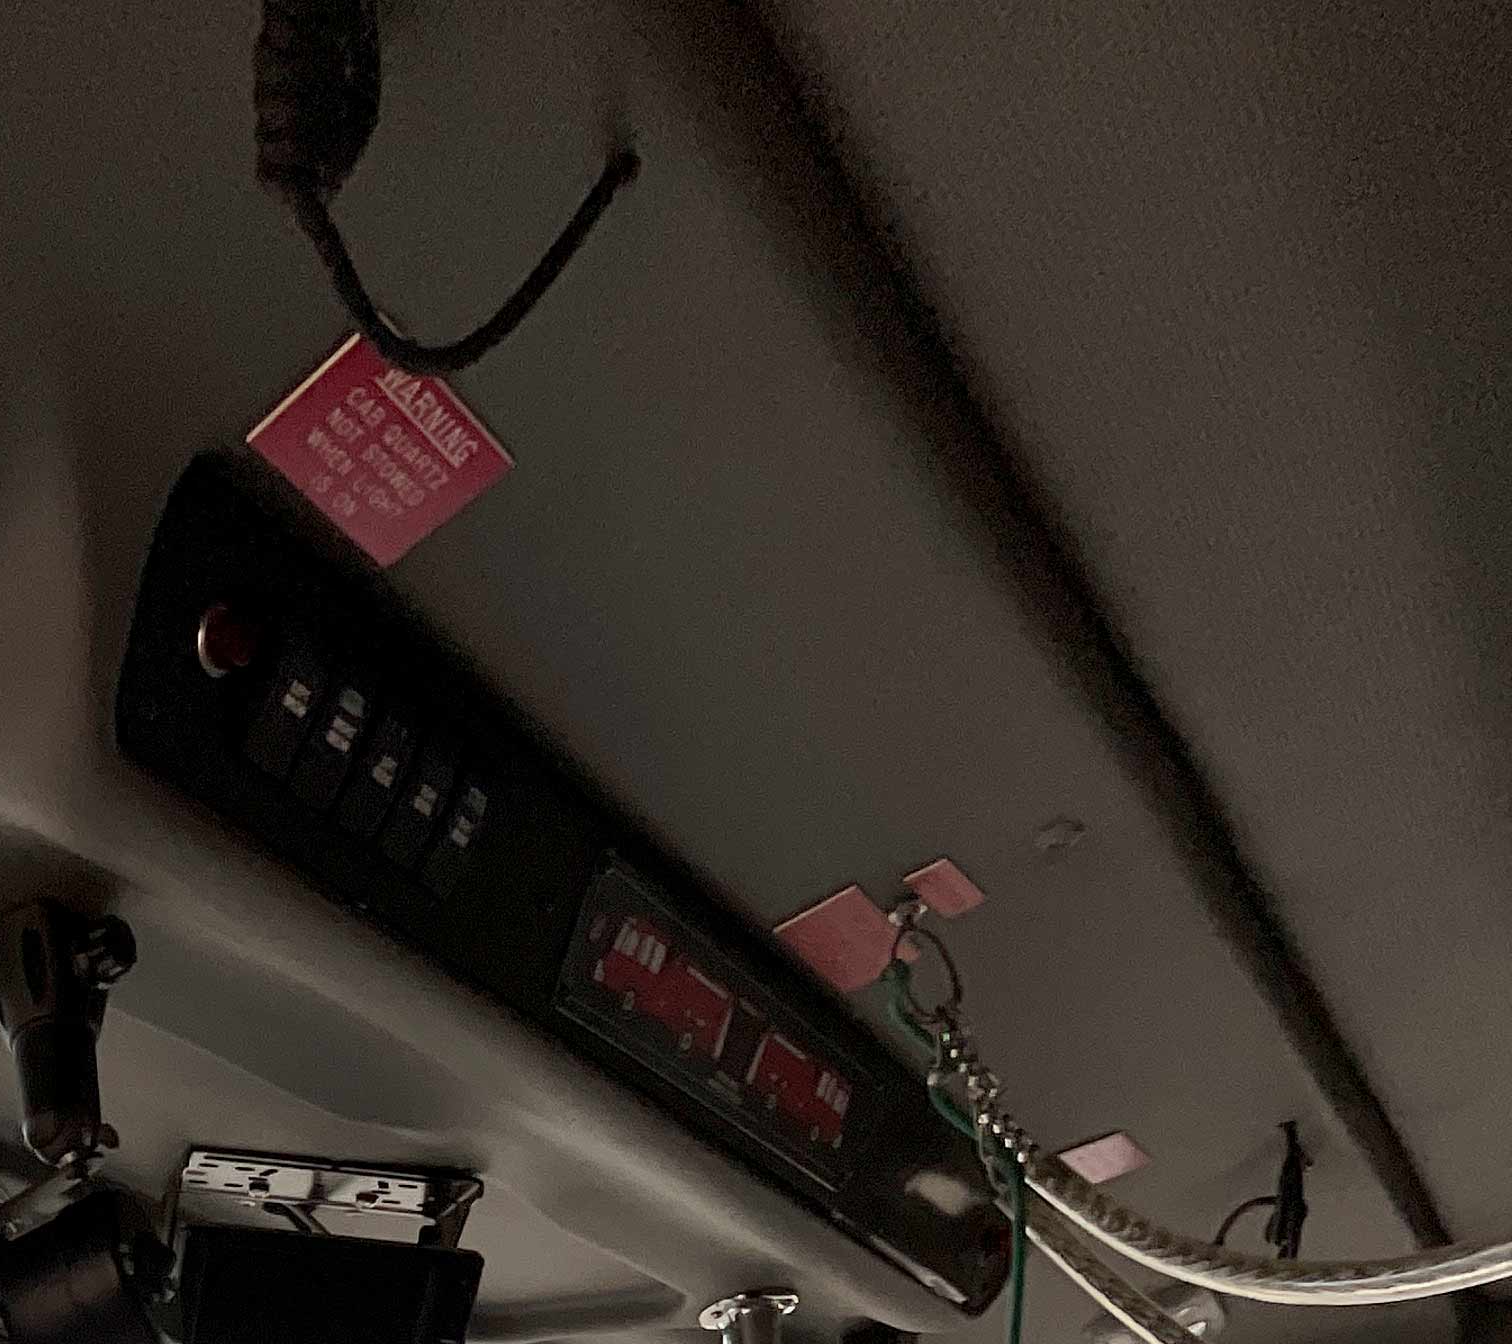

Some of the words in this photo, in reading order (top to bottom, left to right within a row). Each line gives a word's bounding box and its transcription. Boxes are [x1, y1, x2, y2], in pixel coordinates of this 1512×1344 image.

[325, 407, 365, 443] NOT
[346, 386, 386, 427] CAB
[383, 424, 450, 491] QUARTZ
[384, 368, 479, 467] WARNING
